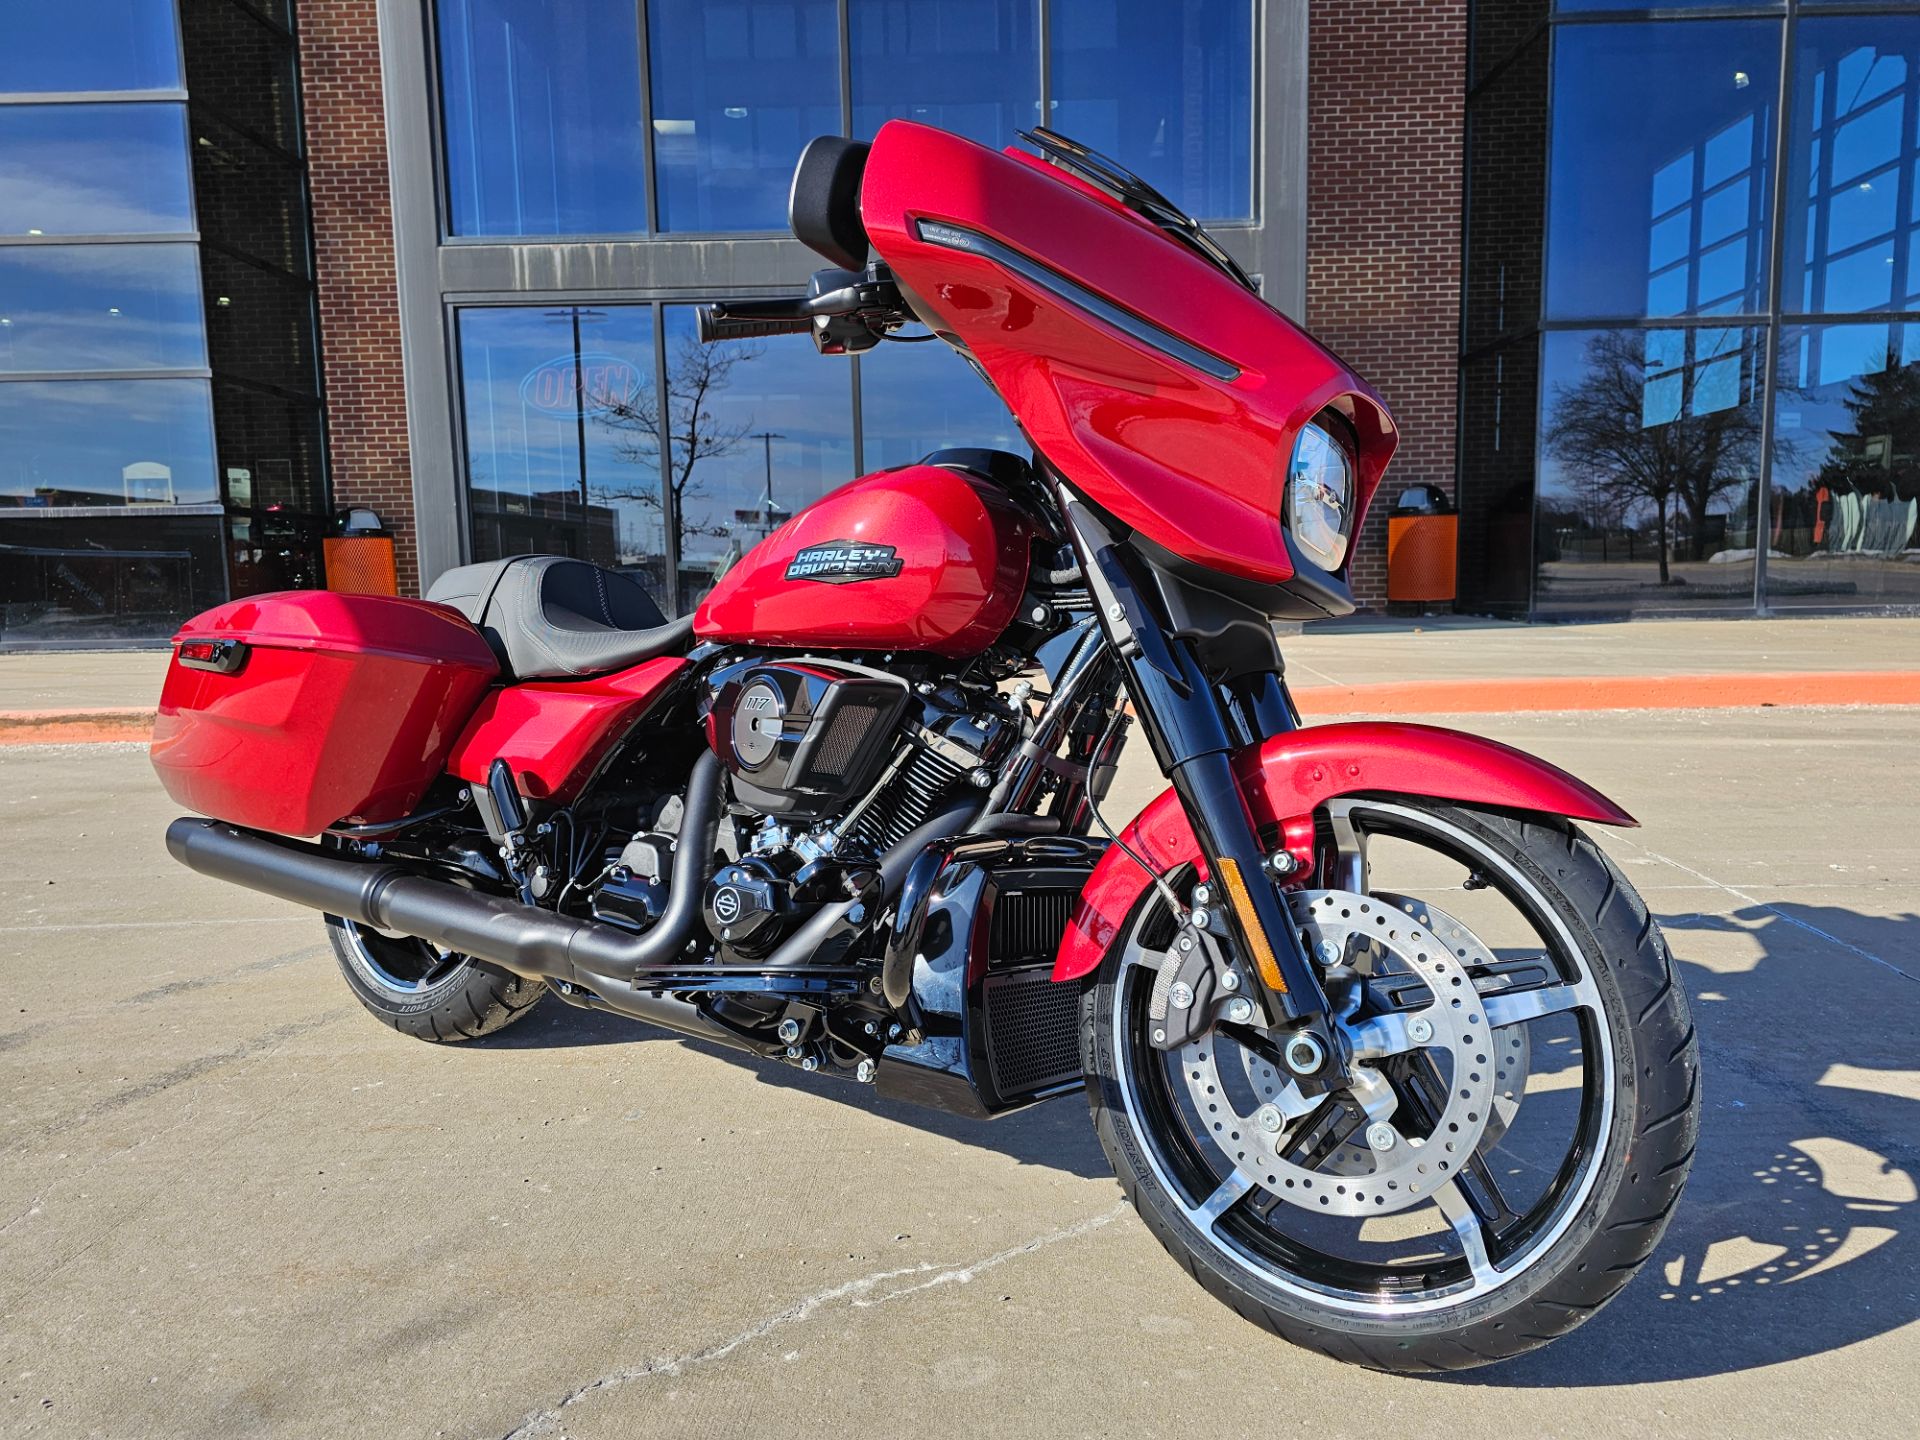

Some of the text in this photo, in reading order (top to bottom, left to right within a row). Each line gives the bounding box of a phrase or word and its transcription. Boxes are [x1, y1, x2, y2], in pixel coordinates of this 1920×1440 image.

[536, 364, 630, 408] OPEN
[787, 561, 897, 576] DAVIDSON
[744, 696, 772, 710] 117
[1115, 1115, 1157, 1190] DUNLOP
